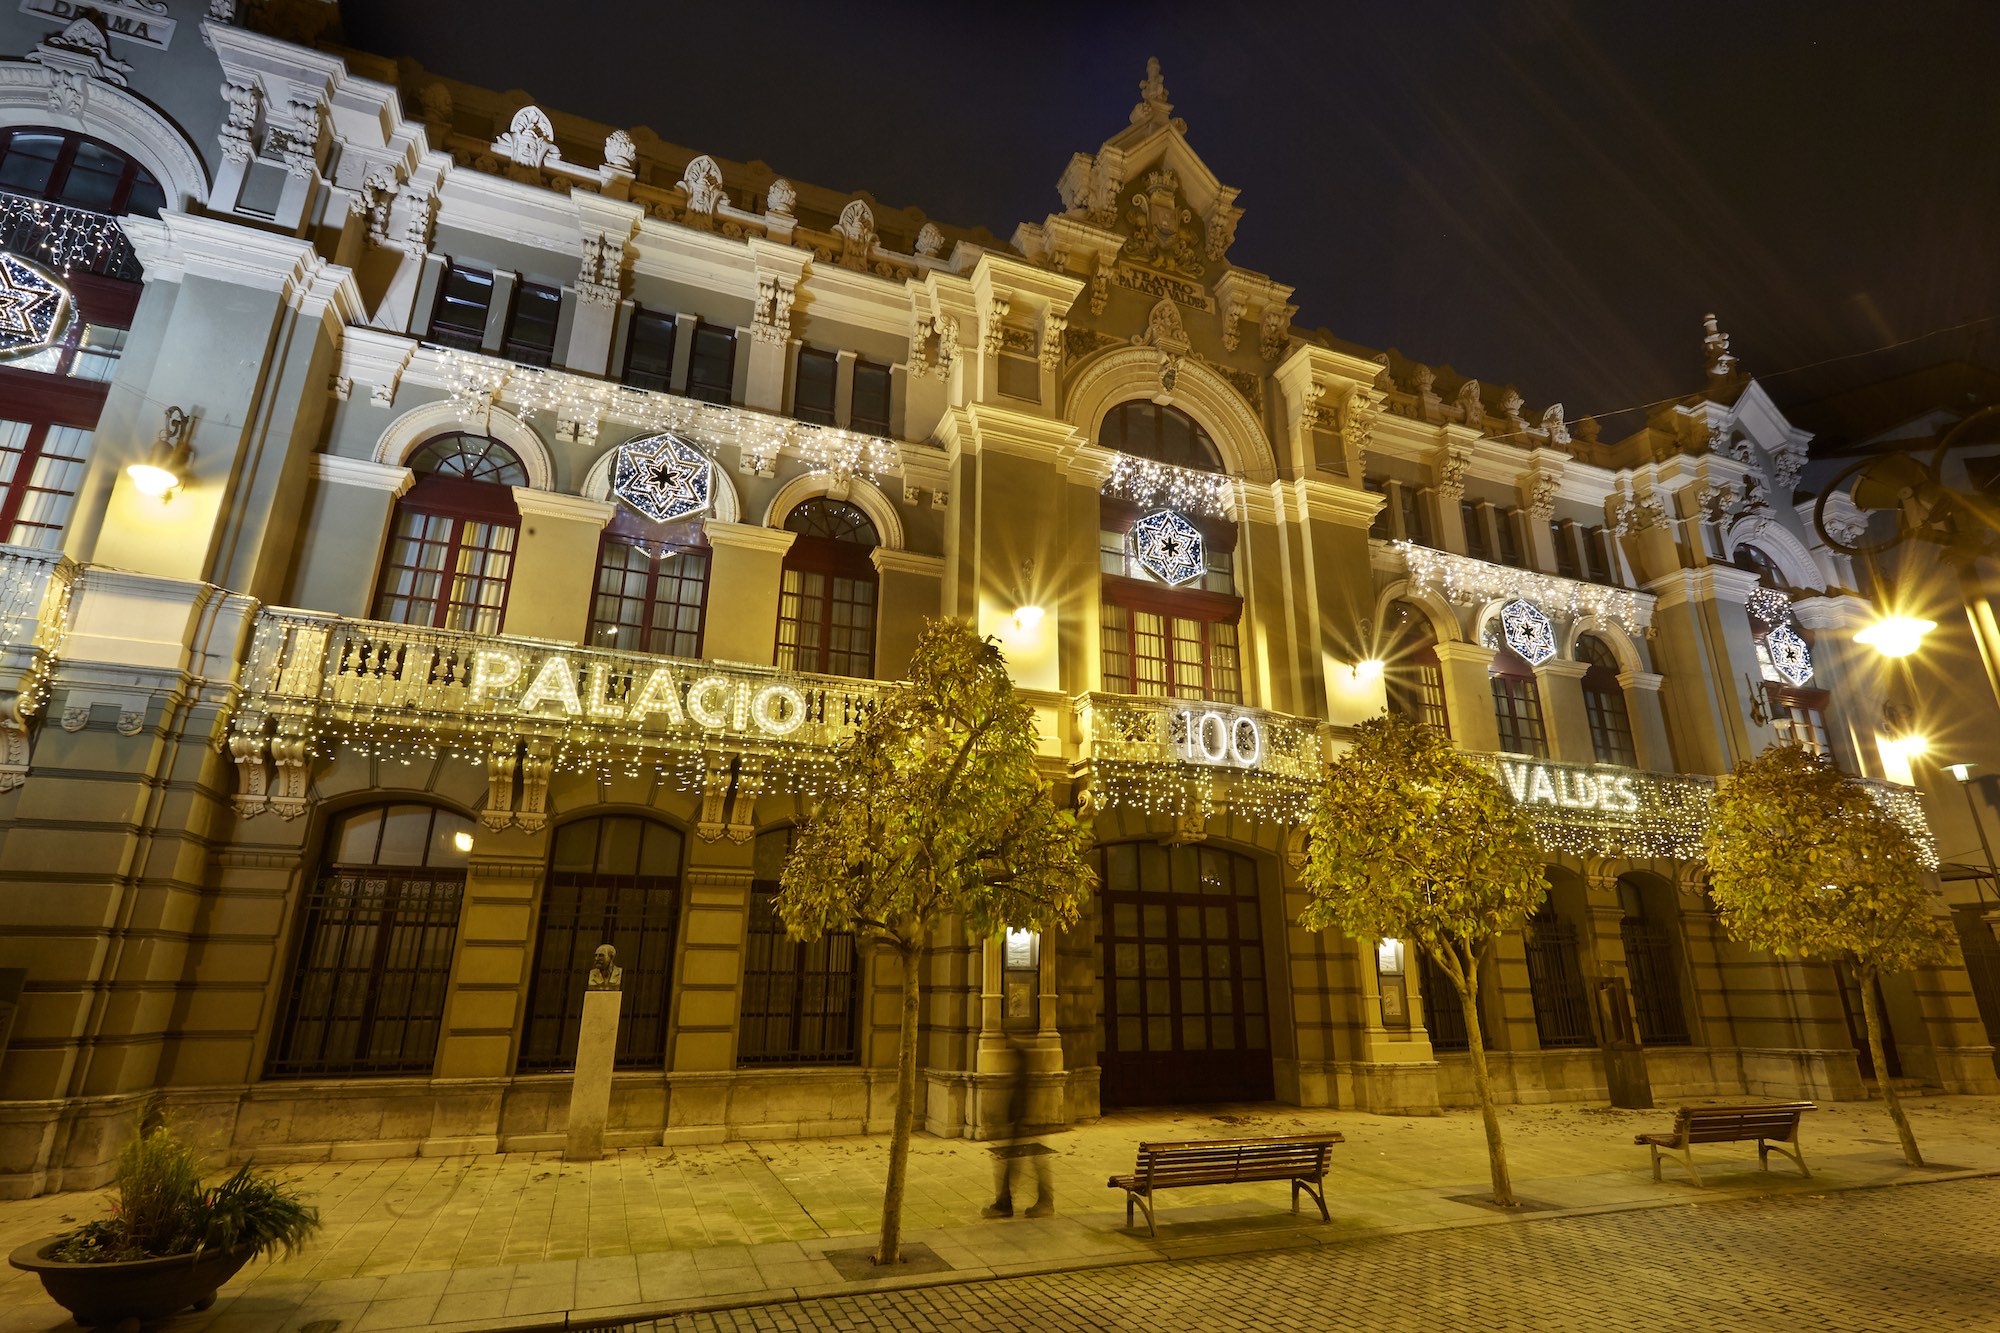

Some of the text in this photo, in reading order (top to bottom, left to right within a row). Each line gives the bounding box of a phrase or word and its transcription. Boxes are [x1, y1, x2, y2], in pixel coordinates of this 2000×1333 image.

[1119, 274, 1165, 296] PALACIO
[1130, 268, 1193, 294] TEATRO
[468, 649, 807, 735] PALACIO
[1181, 710, 1260, 764] 100
[1501, 762, 1639, 813] VALDES
